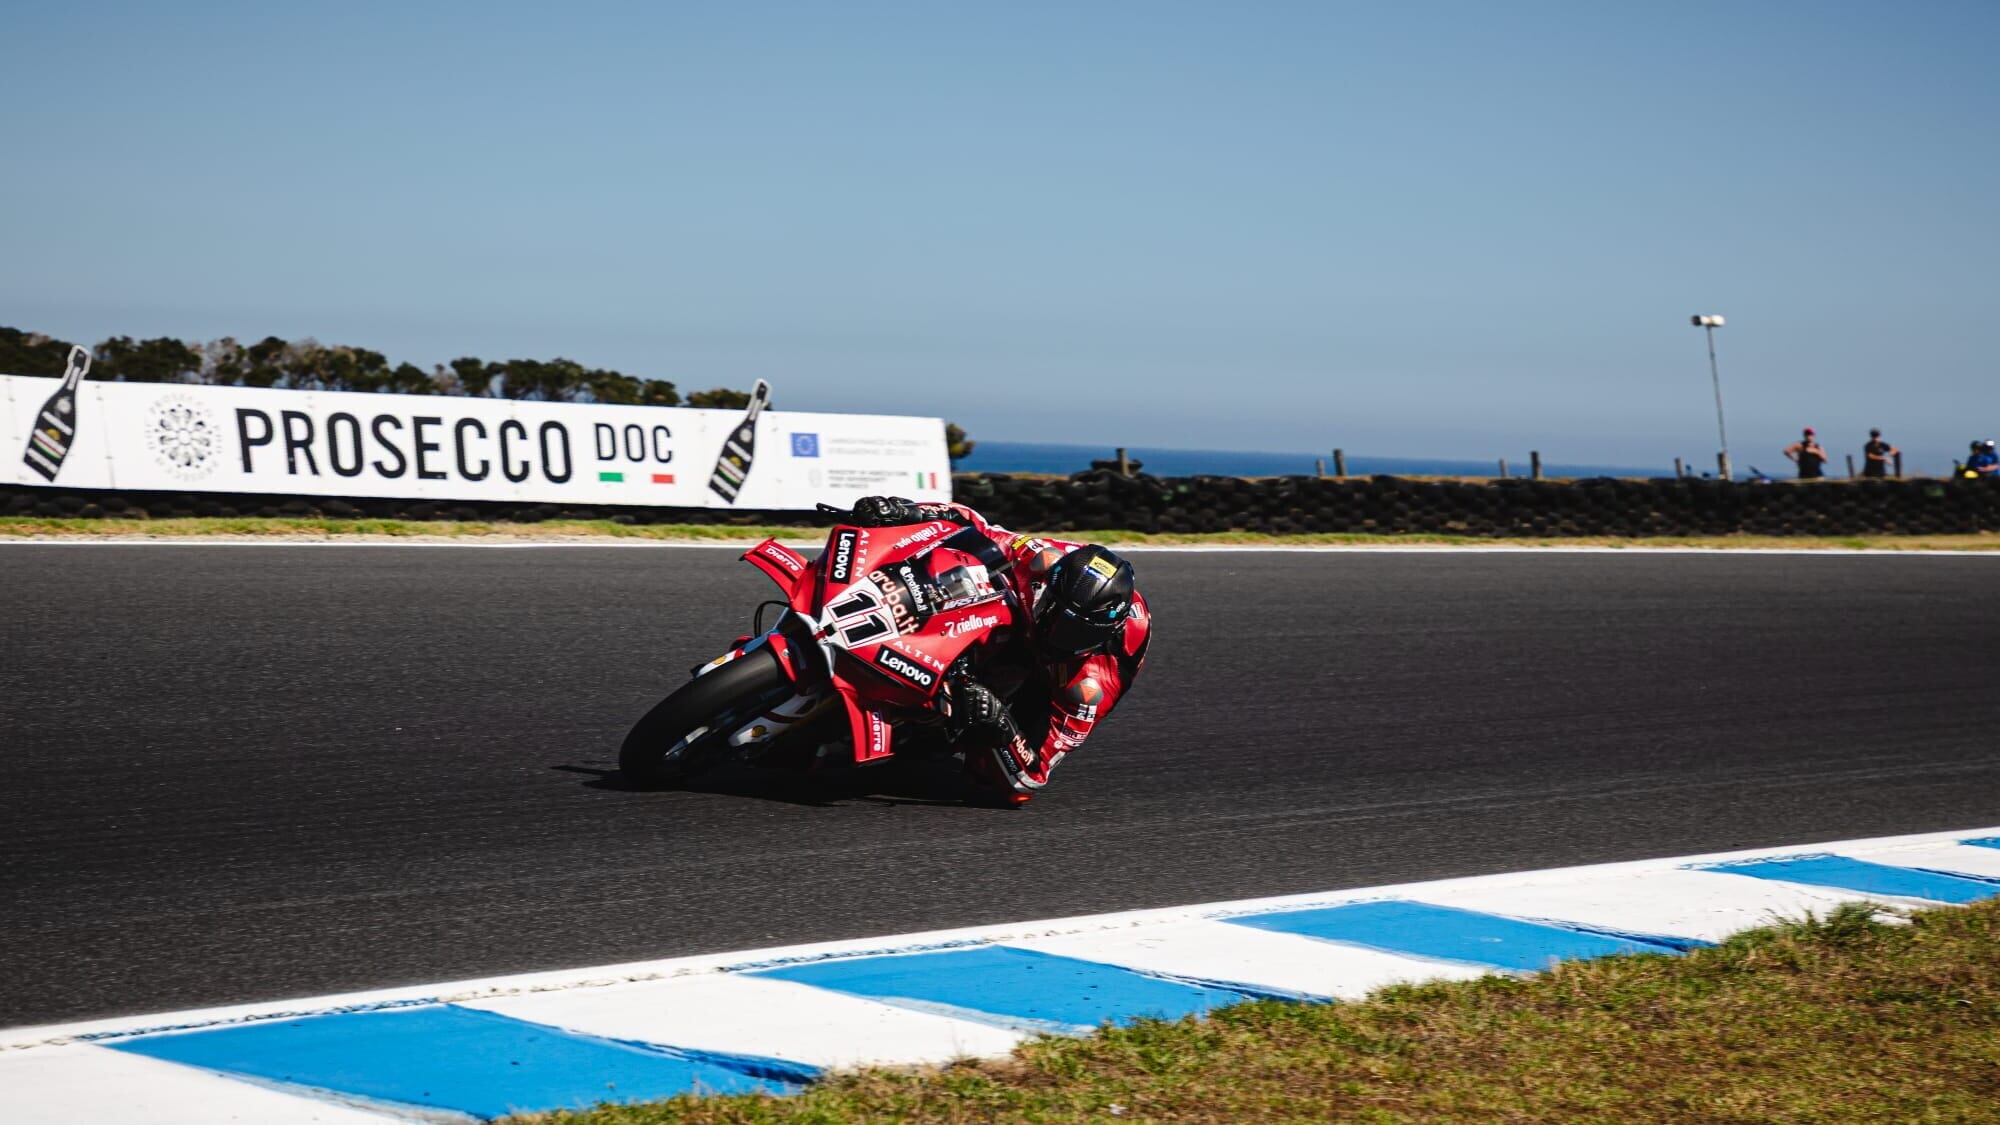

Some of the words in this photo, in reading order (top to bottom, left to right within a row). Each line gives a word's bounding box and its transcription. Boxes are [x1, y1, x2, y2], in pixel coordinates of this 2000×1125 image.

[235, 408, 572, 484] PROSECCO
[594, 423, 672, 463] DOC
[834, 533, 855, 579] Lenovo
[855, 530, 871, 577] ALTEN
[829, 591, 892, 646] 11
[868, 570, 920, 636] aruba.it
[957, 614, 984, 633] riello
[880, 650, 931, 685] Lenovo
[893, 640, 944, 671] ALTEN
